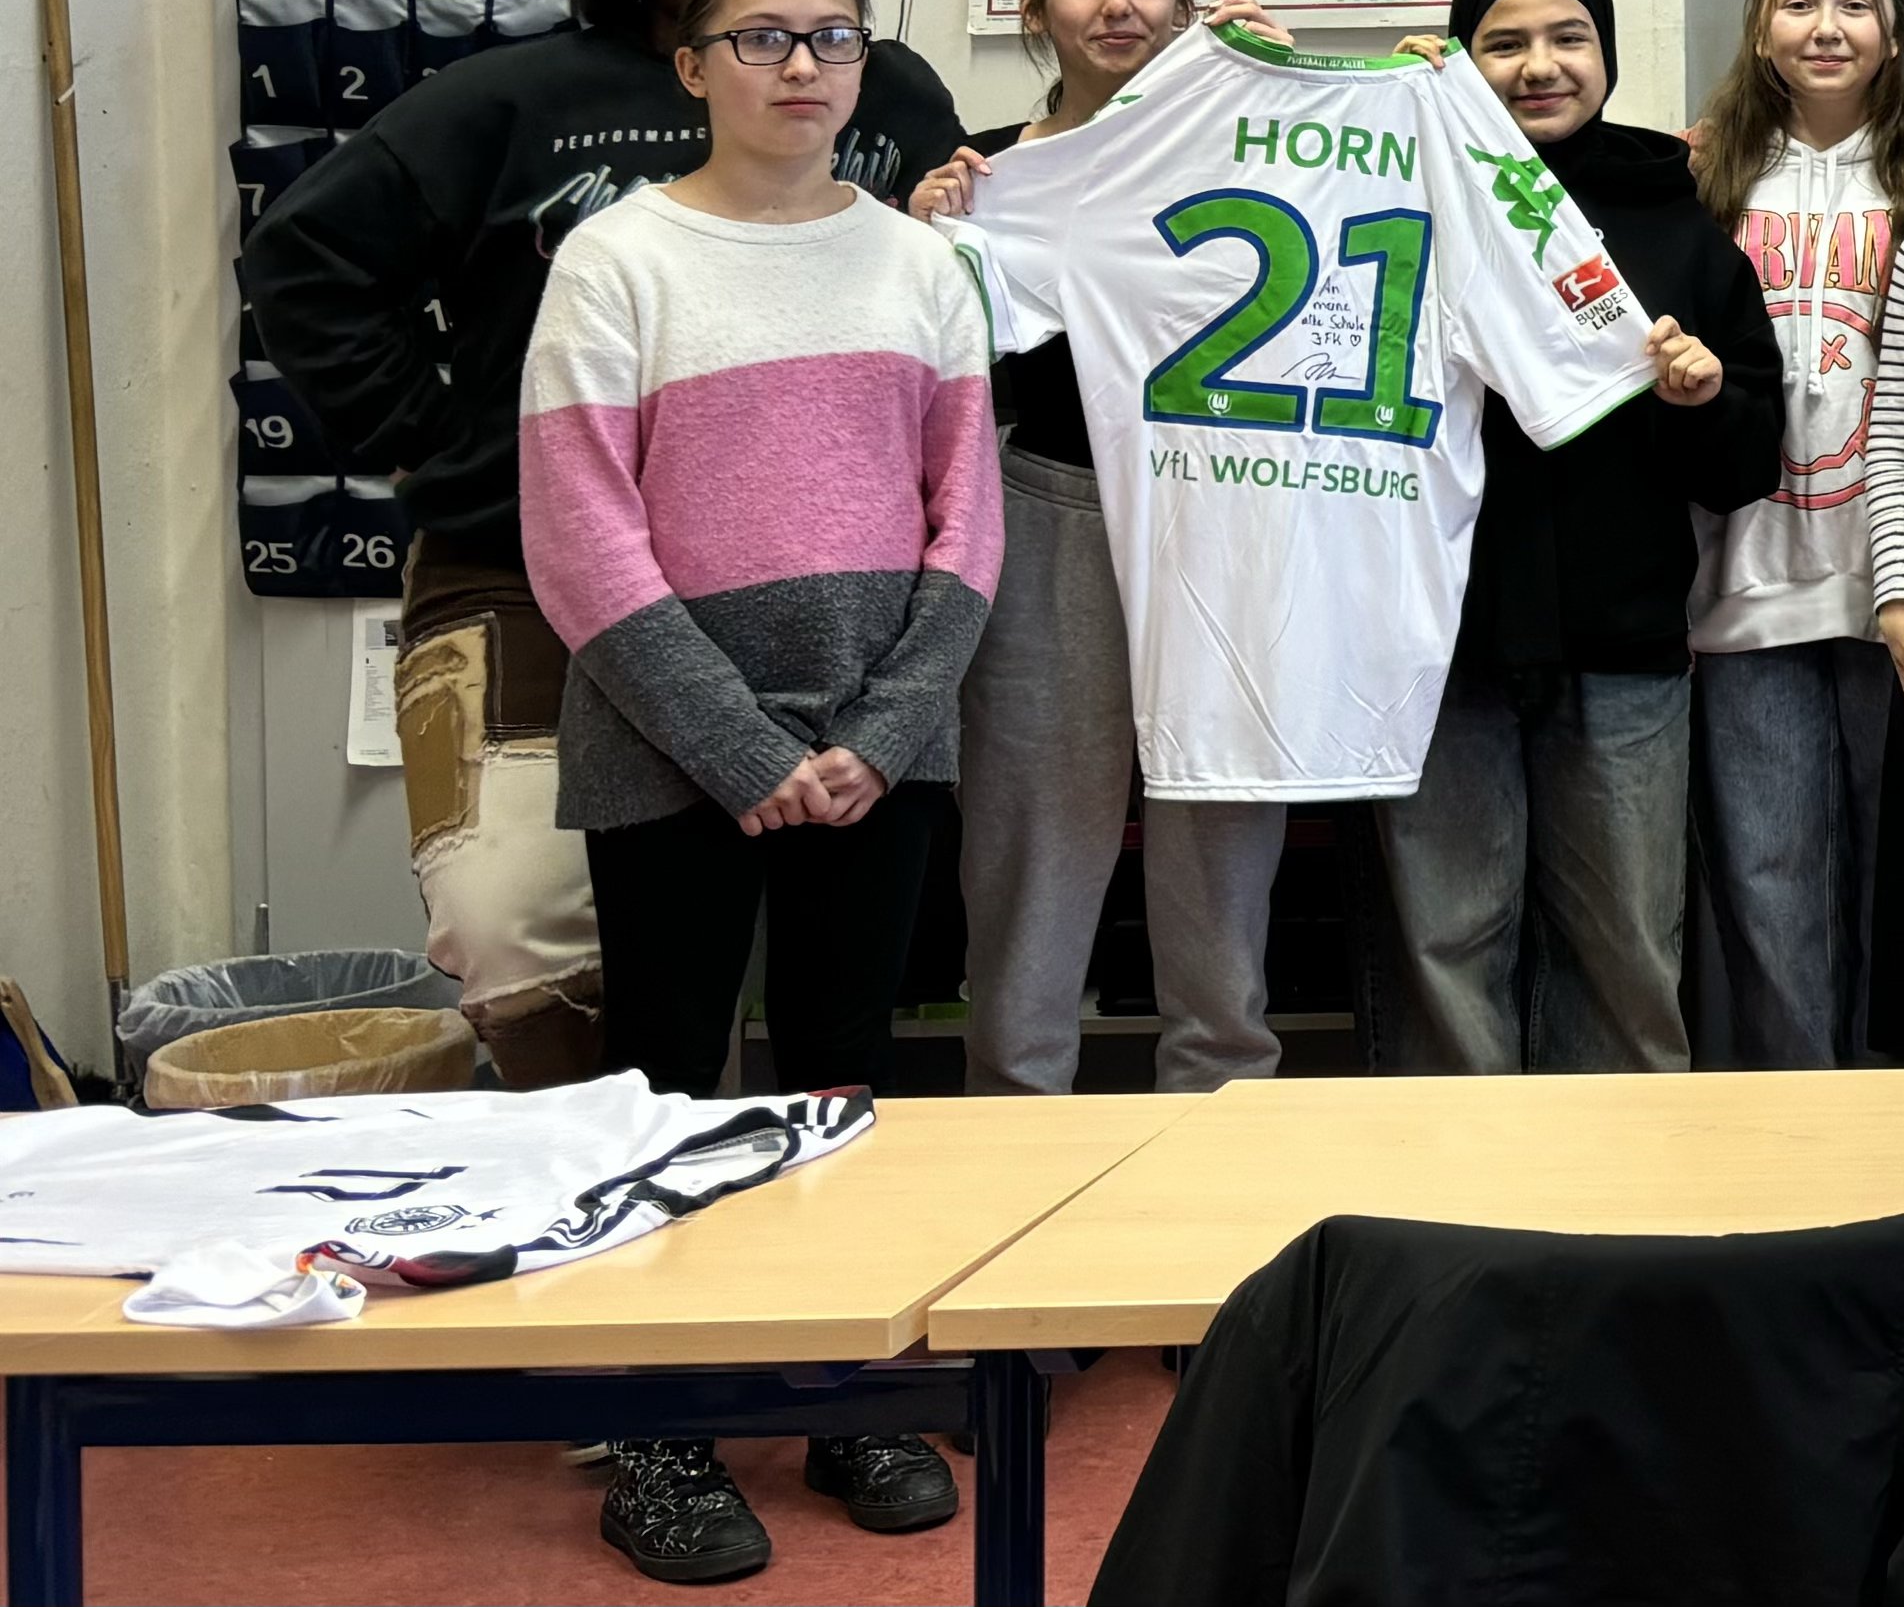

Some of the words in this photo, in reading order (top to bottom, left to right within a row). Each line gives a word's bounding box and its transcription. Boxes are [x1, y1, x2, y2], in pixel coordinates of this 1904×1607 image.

[252, 64, 277, 98] 1
[339, 65, 369, 100] 2
[554, 127, 707, 154] PERFORMANC
[1233, 116, 1416, 182] HORN
[238, 183, 265, 217] 7
[1143, 187, 1443, 449] 21
[1575, 288, 1629, 326] BUNDES
[1591, 305, 1628, 331] LIGA
[245, 415, 294, 449] 19
[1150, 449, 1198, 481] VfL
[1210, 454, 1419, 501] WOLFSBURG
[245, 540, 298, 574] 25
[343, 533, 396, 569] 26
